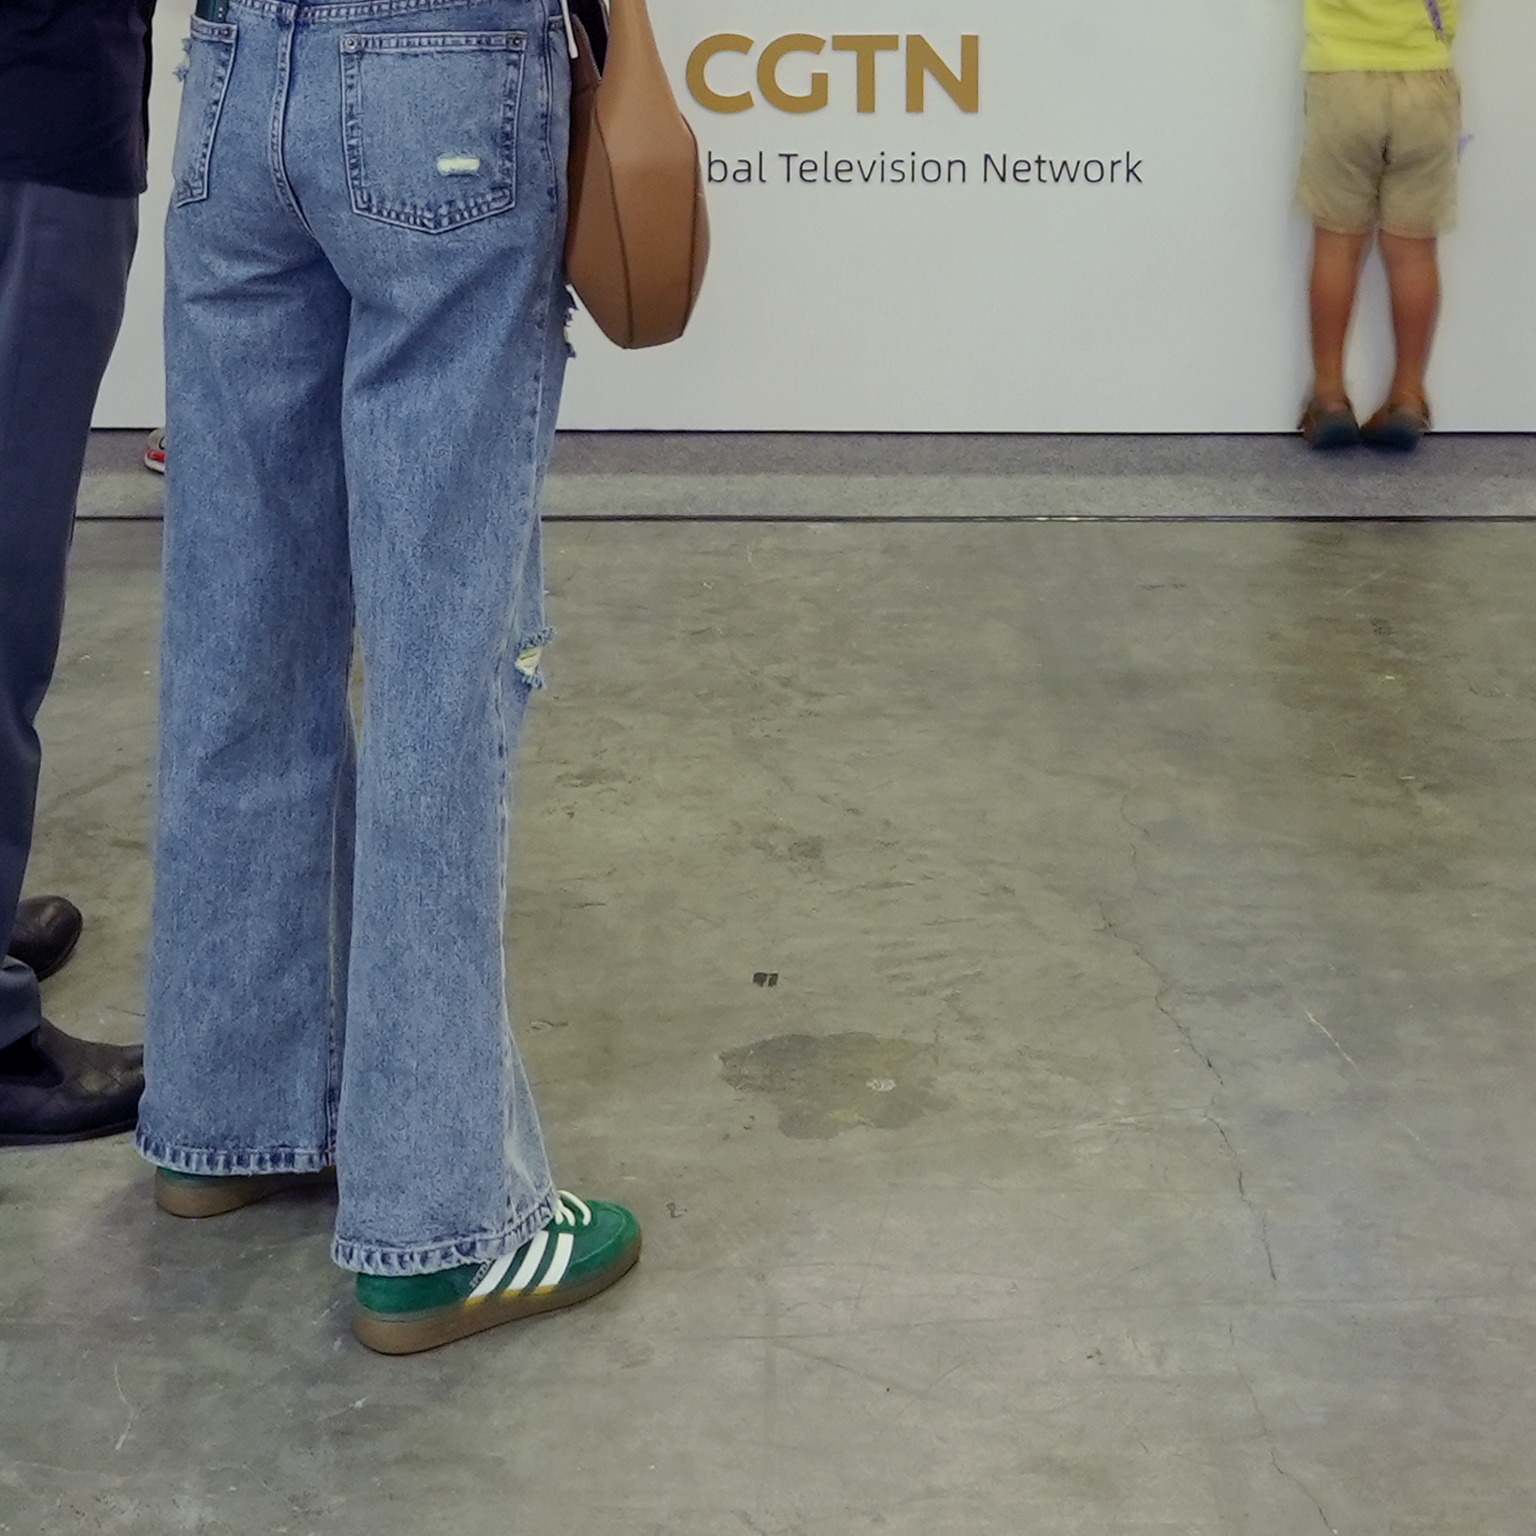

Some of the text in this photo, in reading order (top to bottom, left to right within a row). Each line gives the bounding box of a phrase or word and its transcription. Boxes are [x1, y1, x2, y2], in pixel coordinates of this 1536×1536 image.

[685, 33, 979, 114] CGTN
[707, 150, 1144, 184] bal Television Network
